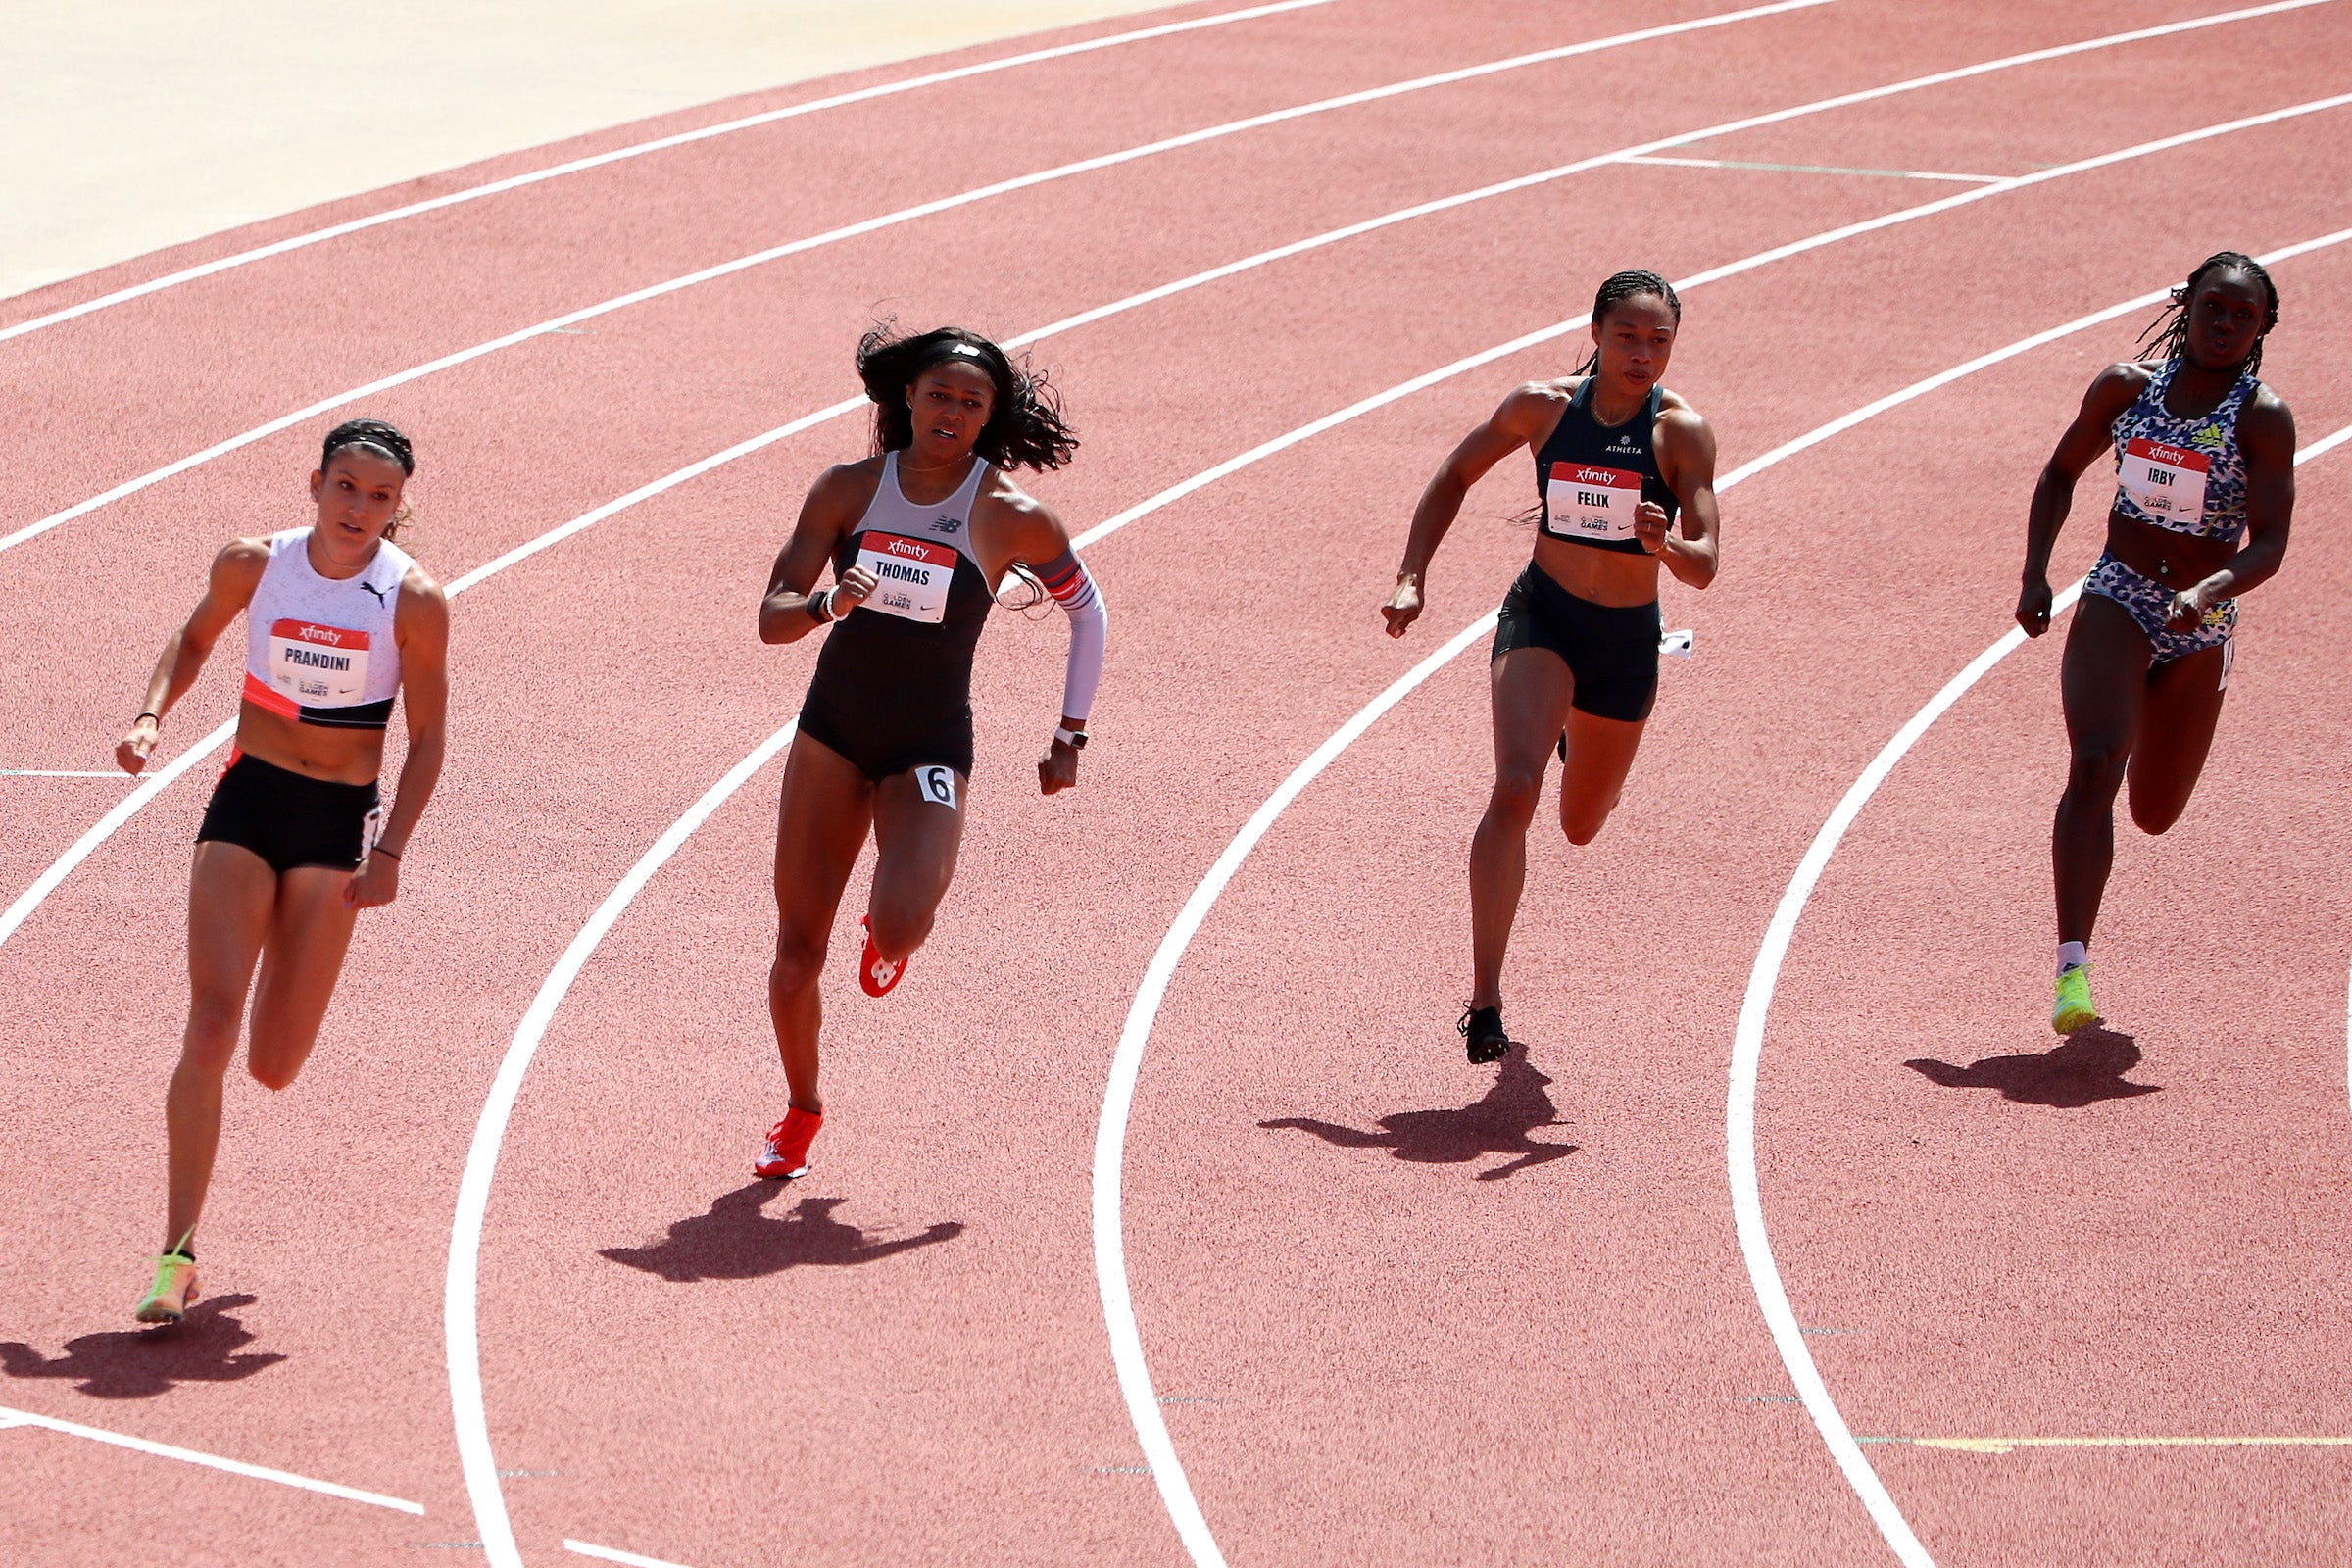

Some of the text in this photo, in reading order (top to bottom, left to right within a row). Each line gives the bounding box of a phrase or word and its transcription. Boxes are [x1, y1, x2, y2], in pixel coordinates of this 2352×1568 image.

[2148, 446, 2185, 465] xfinity
[1576, 468, 1616, 485] xfinity
[2147, 467, 2176, 486] IRBY
[1577, 491, 1609, 508] FELIX
[888, 540, 929, 560] xfinity
[876, 561, 930, 586] THOMAS
[883, 599, 910, 610] GAMES
[299, 625, 342, 645] xfinity
[285, 648, 350, 671] PRANDINI
[299, 686, 328, 697] GAMES
[927, 767, 951, 802] 6
